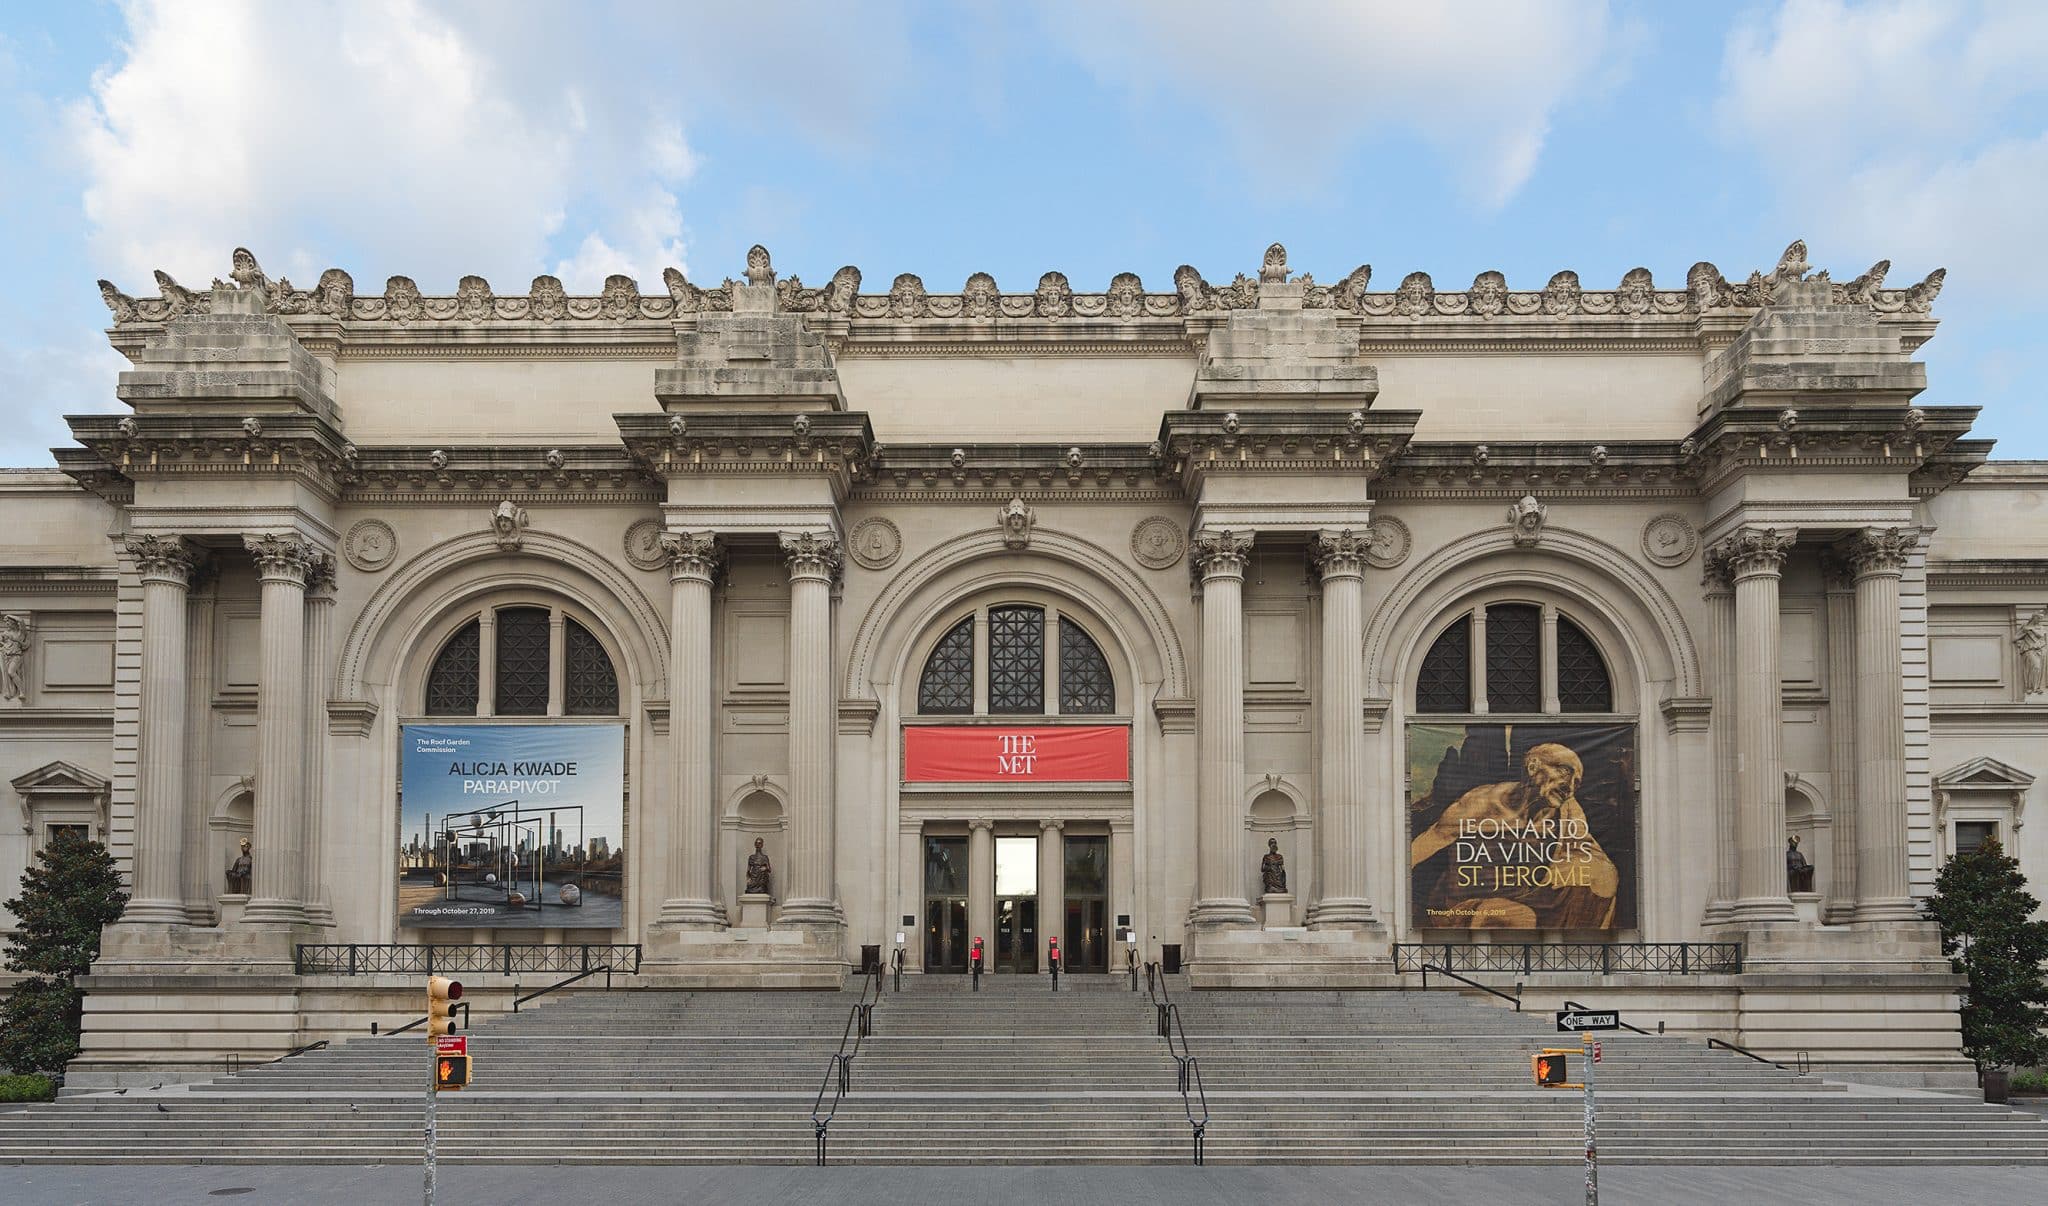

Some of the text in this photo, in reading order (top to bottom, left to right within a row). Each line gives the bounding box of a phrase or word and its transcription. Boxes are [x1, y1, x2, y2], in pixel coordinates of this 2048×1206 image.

[998, 735, 1036, 754] THE
[448, 762, 577, 776] ALICJA KWADE
[997, 755, 1037, 774] MET
[463, 780, 561, 794] PARAPIVOT
[1459, 818, 1589, 840] LEONARDO
[1455, 841, 1593, 864] DA VINCI'S
[1457, 865, 1591, 892] ST. JEROME
[413, 907, 441, 916] Through
[442, 907, 469, 915] October
[479, 907, 495, 915] 2019
[1426, 908, 1455, 917] Through
[1455, 908, 1482, 916] October
[1566, 1016, 1611, 1025] ONE WAY
